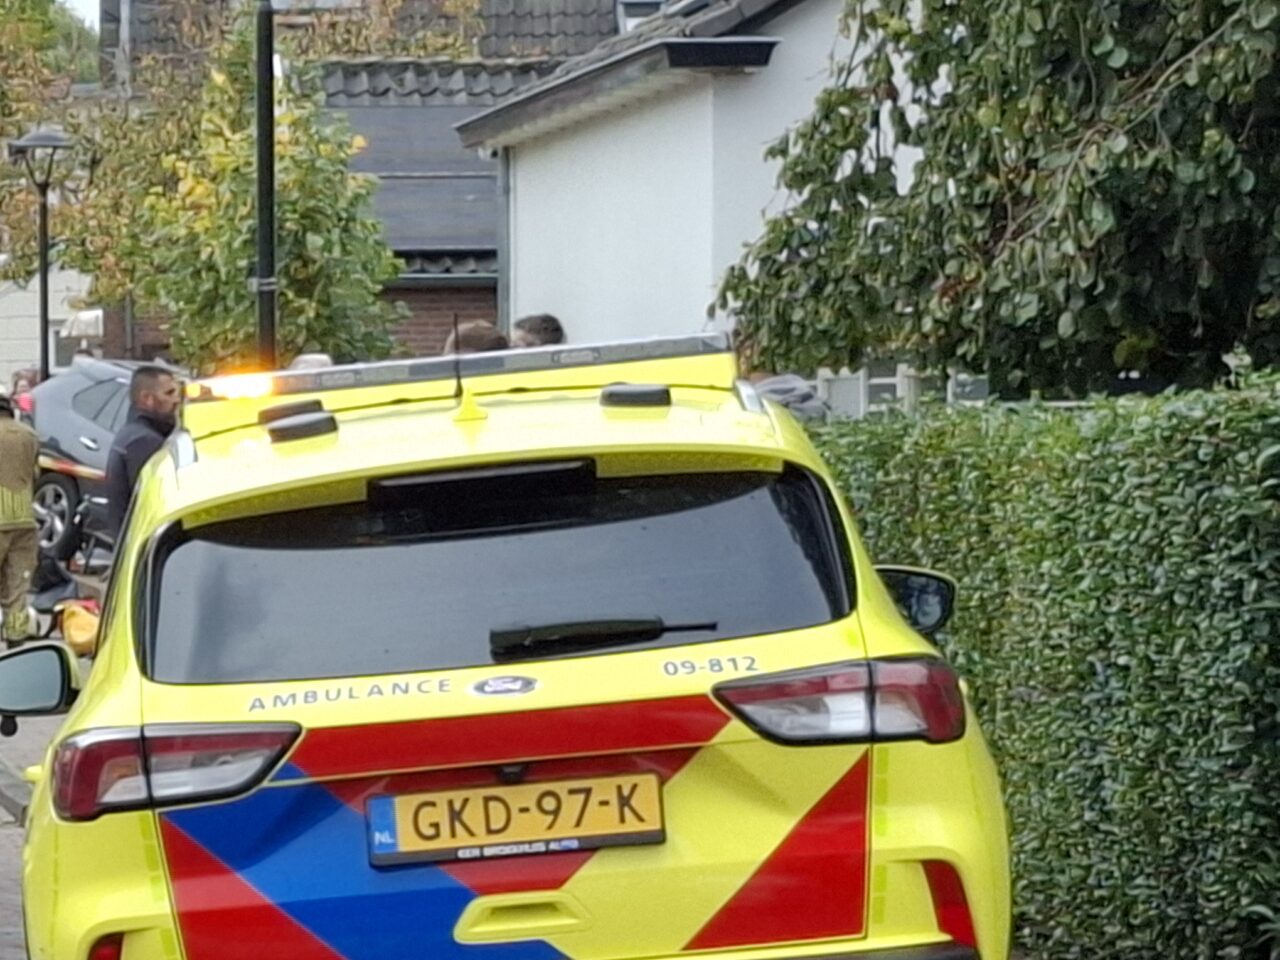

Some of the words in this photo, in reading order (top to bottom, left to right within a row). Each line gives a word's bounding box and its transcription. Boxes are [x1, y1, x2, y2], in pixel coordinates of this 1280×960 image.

[663, 655, 758, 676] 09-812
[248, 678, 452, 713] AMBULANCE
[412, 782, 646, 841] GKD-97-K
